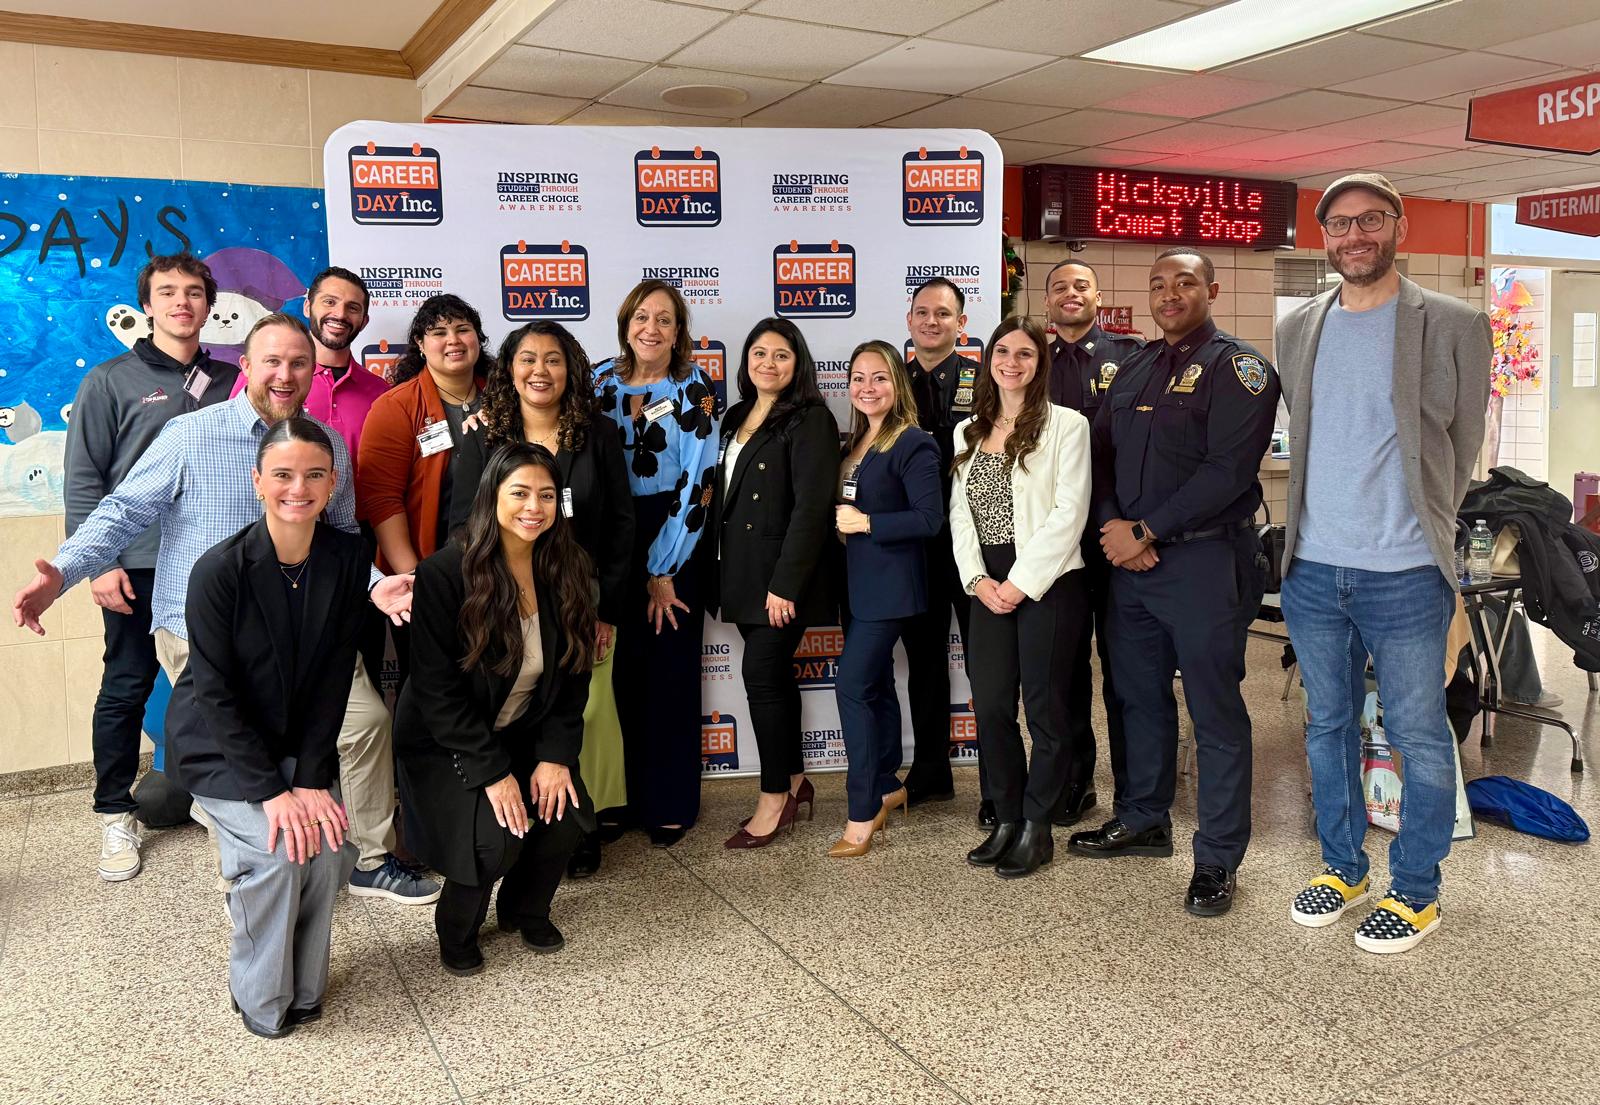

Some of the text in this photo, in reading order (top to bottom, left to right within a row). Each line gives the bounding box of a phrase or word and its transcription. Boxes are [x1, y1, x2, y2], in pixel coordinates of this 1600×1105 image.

[355, 164, 435, 185] CAREER
[497, 172, 579, 184] INSPIRING
[640, 168, 715, 188] CAREER
[773, 174, 849, 185] INSPIRING
[907, 168, 978, 188] CAREER
[498, 184, 578, 193] STUDENTS THROUGH
[773, 186, 849, 194] STUDENTS THROUGH
[1097, 172, 1263, 211] Hicksville
[356, 194, 437, 212] DAY Inc.
[498, 194, 579, 203] CAREER CHOICE
[773, 196, 849, 204] CAREER CHOICE
[641, 197, 716, 214] DAY Inc.
[907, 197, 979, 214] DAY Inc.
[1096, 205, 1262, 244] Comet Shop
[359, 267, 443, 279] INSPIRING
[506, 262, 583, 282] CAREER
[642, 267, 720, 278] INSPIRING
[779, 262, 850, 281] CAREER
[906, 265, 980, 277] INSPIRING
[365, 280, 442, 288] TUDENTS THROUGH
[369, 290, 402, 298] AREER
[683, 289, 720, 297] CHOICE
[779, 290, 851, 306] DAY Inc.
[507, 292, 584, 309] DAY Inc.
[799, 634, 844, 653] AREE
[703, 665, 730, 673] HOICE
[803, 730, 843, 741] SPIRI
[802, 750, 826, 759] REER
